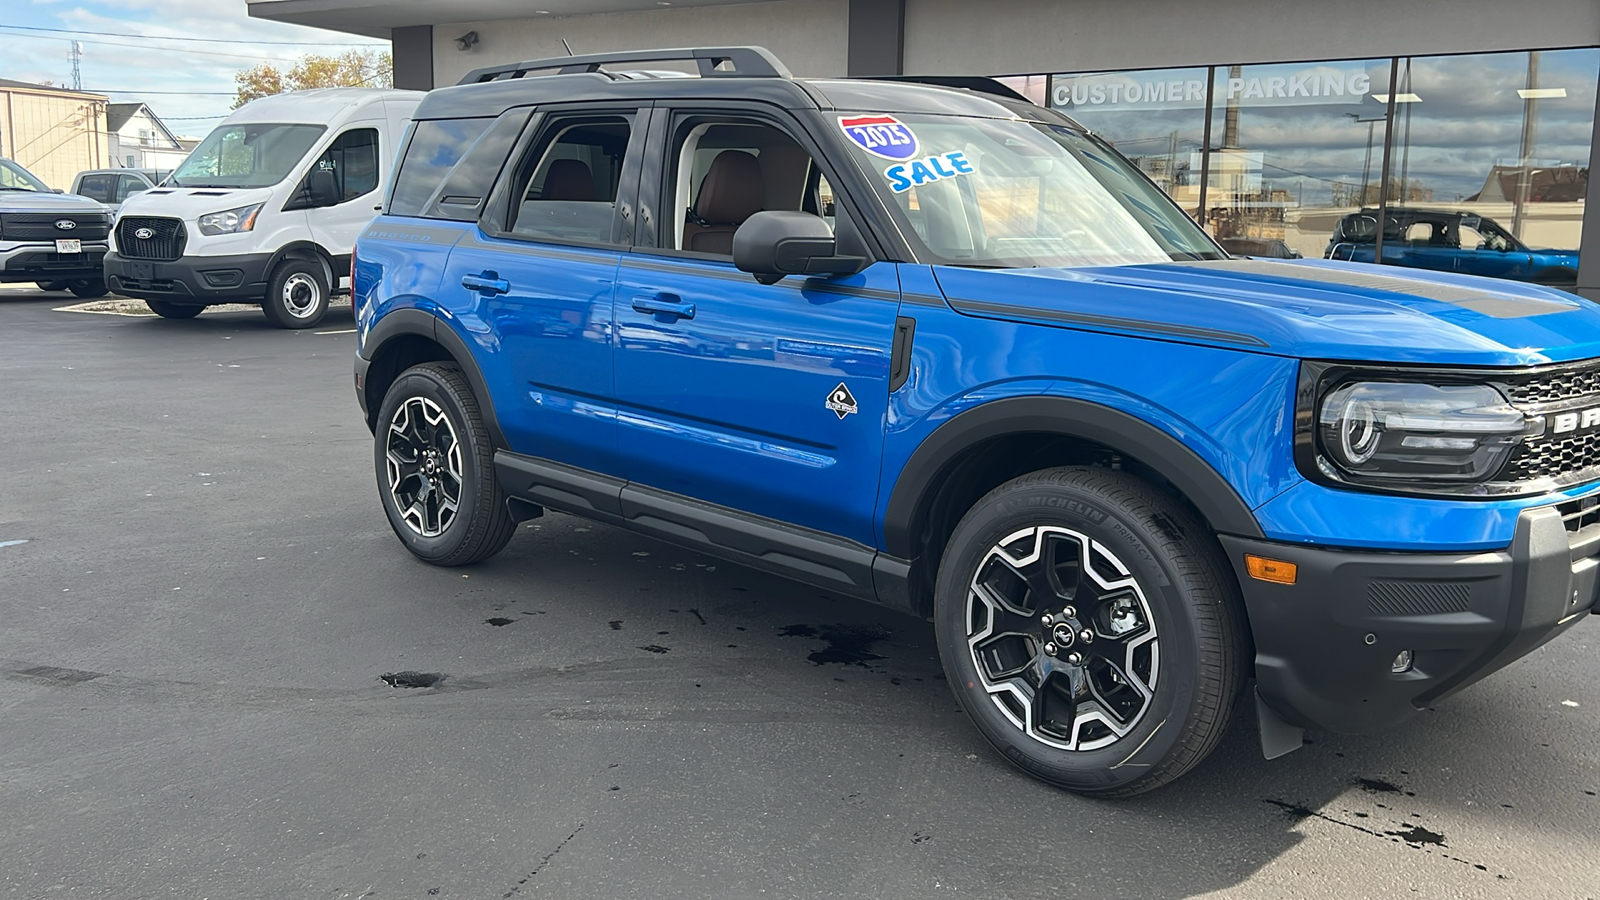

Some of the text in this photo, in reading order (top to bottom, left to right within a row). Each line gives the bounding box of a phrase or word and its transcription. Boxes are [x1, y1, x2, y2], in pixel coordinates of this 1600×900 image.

[1053, 73, 1370, 106] CUSTOMER PARKING
[853, 125, 911, 149] 2025
[886, 152, 974, 192] SALE
[1029, 496, 1104, 522] MICHELIN
[1113, 523, 1153, 562] PRIMACY
